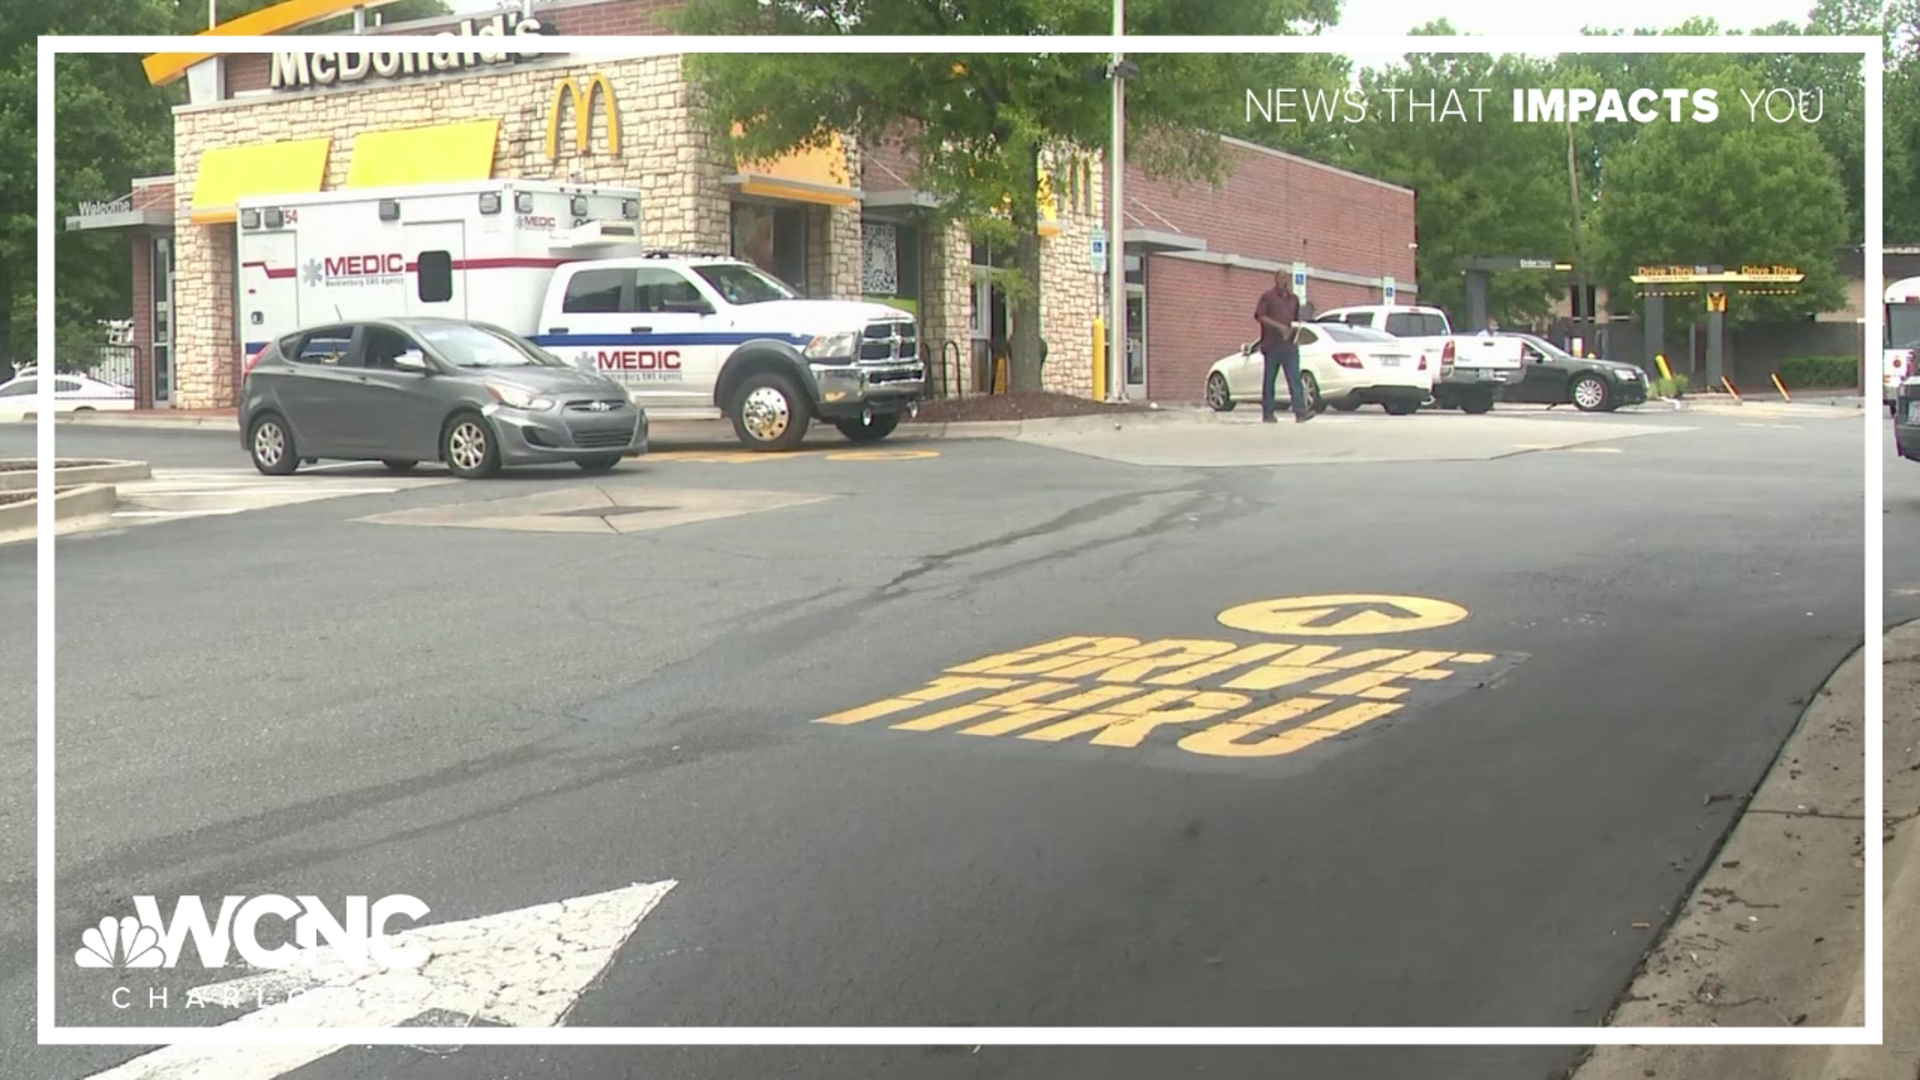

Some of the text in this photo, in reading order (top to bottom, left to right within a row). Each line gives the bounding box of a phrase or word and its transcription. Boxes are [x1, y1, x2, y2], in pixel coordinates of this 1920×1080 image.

[270, 11, 542, 88] McDonald's
[79, 200, 130, 216] Welcome
[284, 209, 298, 224] 54
[524, 216, 556, 228] MEDIC
[324, 253, 403, 276] MEDIC
[1638, 266, 1667, 277] Drive
[1669, 266, 1694, 276] Thru
[1741, 265, 1798, 275] Drive Thru
[598, 351, 682, 369] MEDIC
[942, 636, 1494, 697] DRIVE
[812, 675, 1405, 757] THRU
